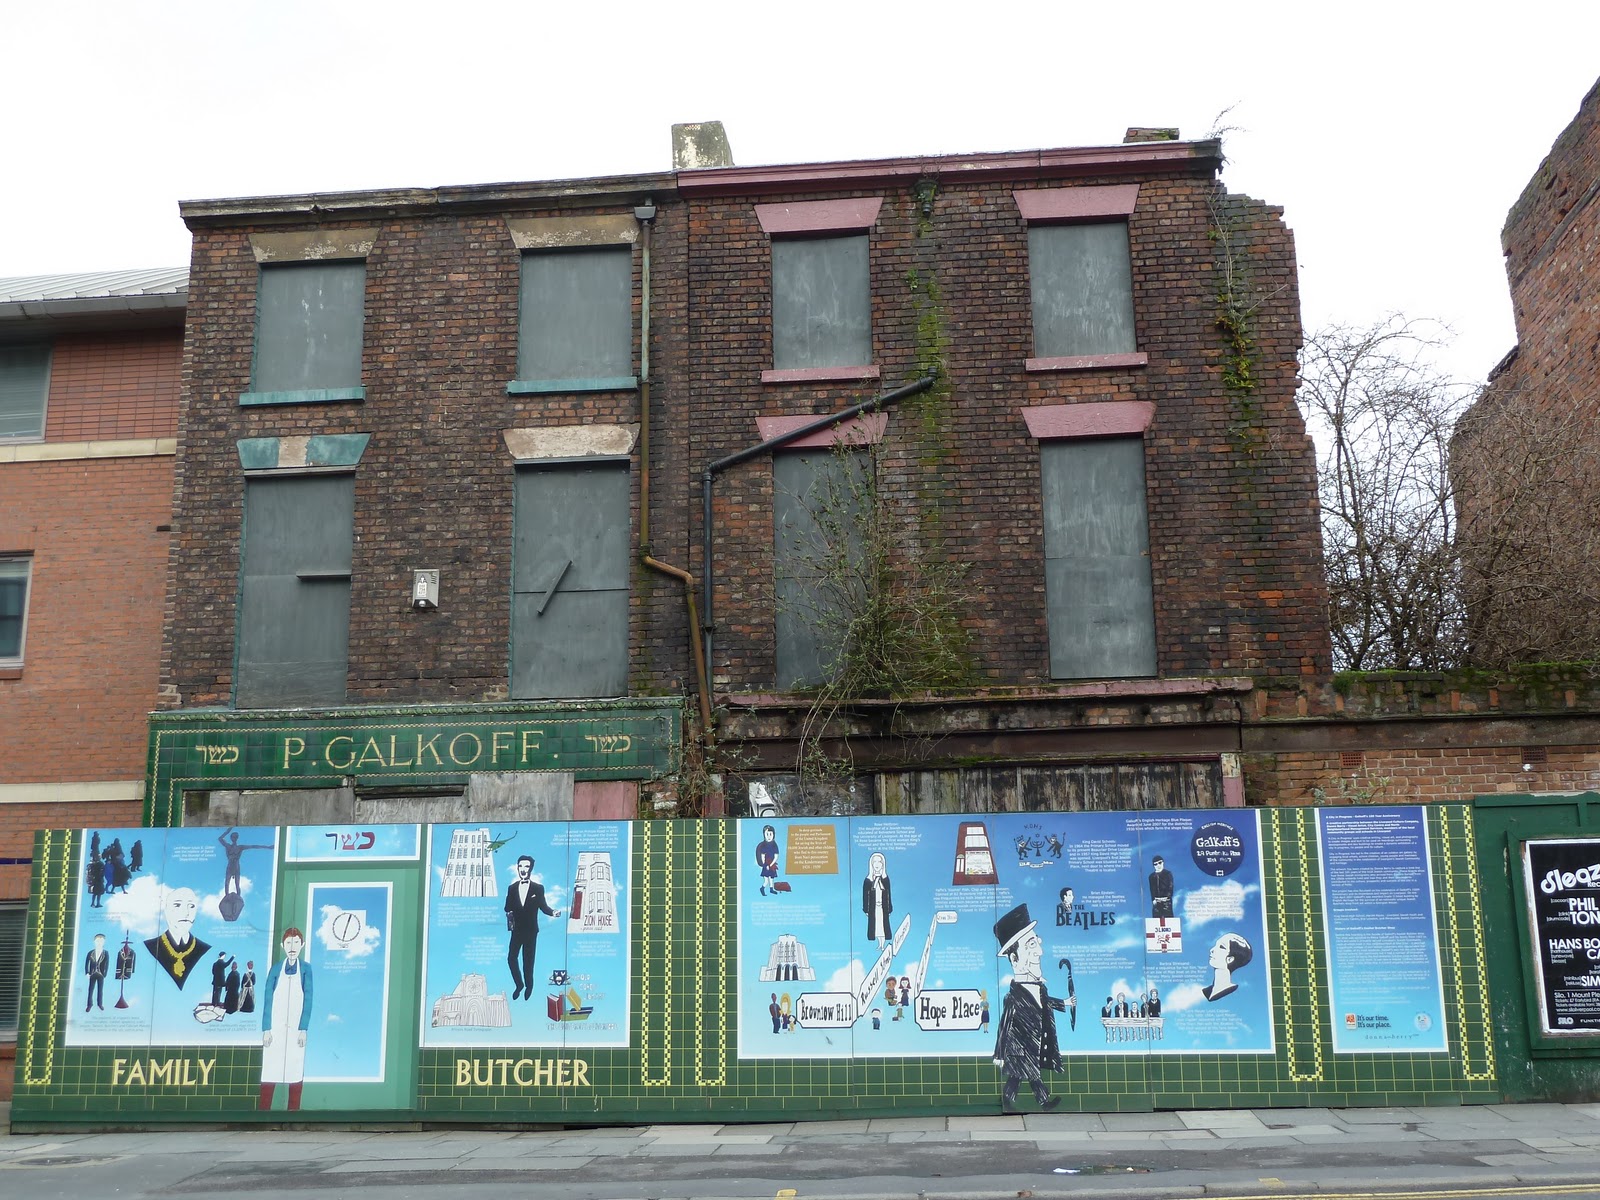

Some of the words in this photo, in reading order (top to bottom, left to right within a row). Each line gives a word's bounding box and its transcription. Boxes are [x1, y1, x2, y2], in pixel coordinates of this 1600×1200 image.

[584, 734, 632, 753] כשר
[195, 744, 240, 765] כשר
[325, 831, 376, 851] כשר
[1569, 897, 1599, 911] PHIL
[1056, 904, 1116, 930] BEATLES
[1549, 938, 1582, 949] HANS
[836, 1003, 852, 1021] Hill
[920, 997, 946, 1027] Hope
[952, 996, 979, 1018] Place
[112, 1058, 216, 1086] FAMILY
[456, 1058, 591, 1086] BUTCHER
